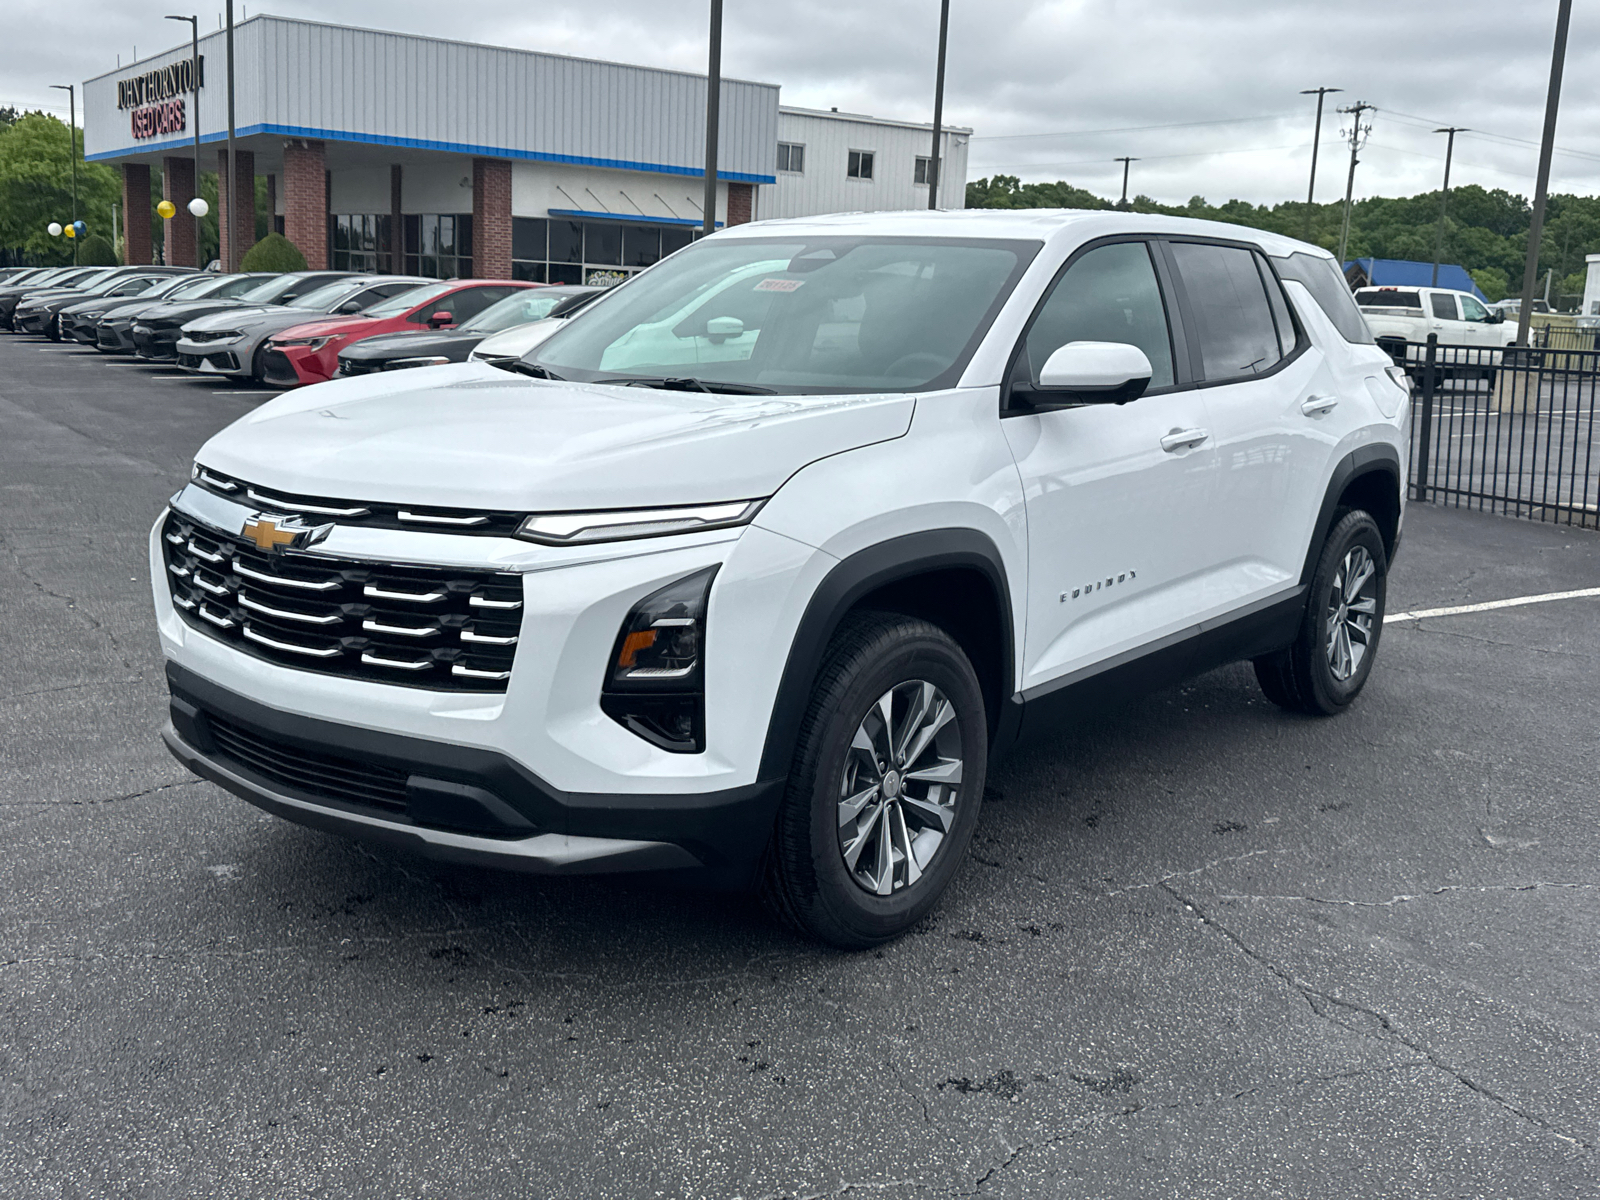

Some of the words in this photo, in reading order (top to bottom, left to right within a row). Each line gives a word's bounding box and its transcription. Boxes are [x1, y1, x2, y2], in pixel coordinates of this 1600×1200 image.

[117, 76, 143, 110] JOHN
[142, 54, 204, 104] THORNTO
[131, 107, 157, 139] USED
[156, 99, 186, 134] CARS
[1059, 568, 1137, 603] EQUINOX
